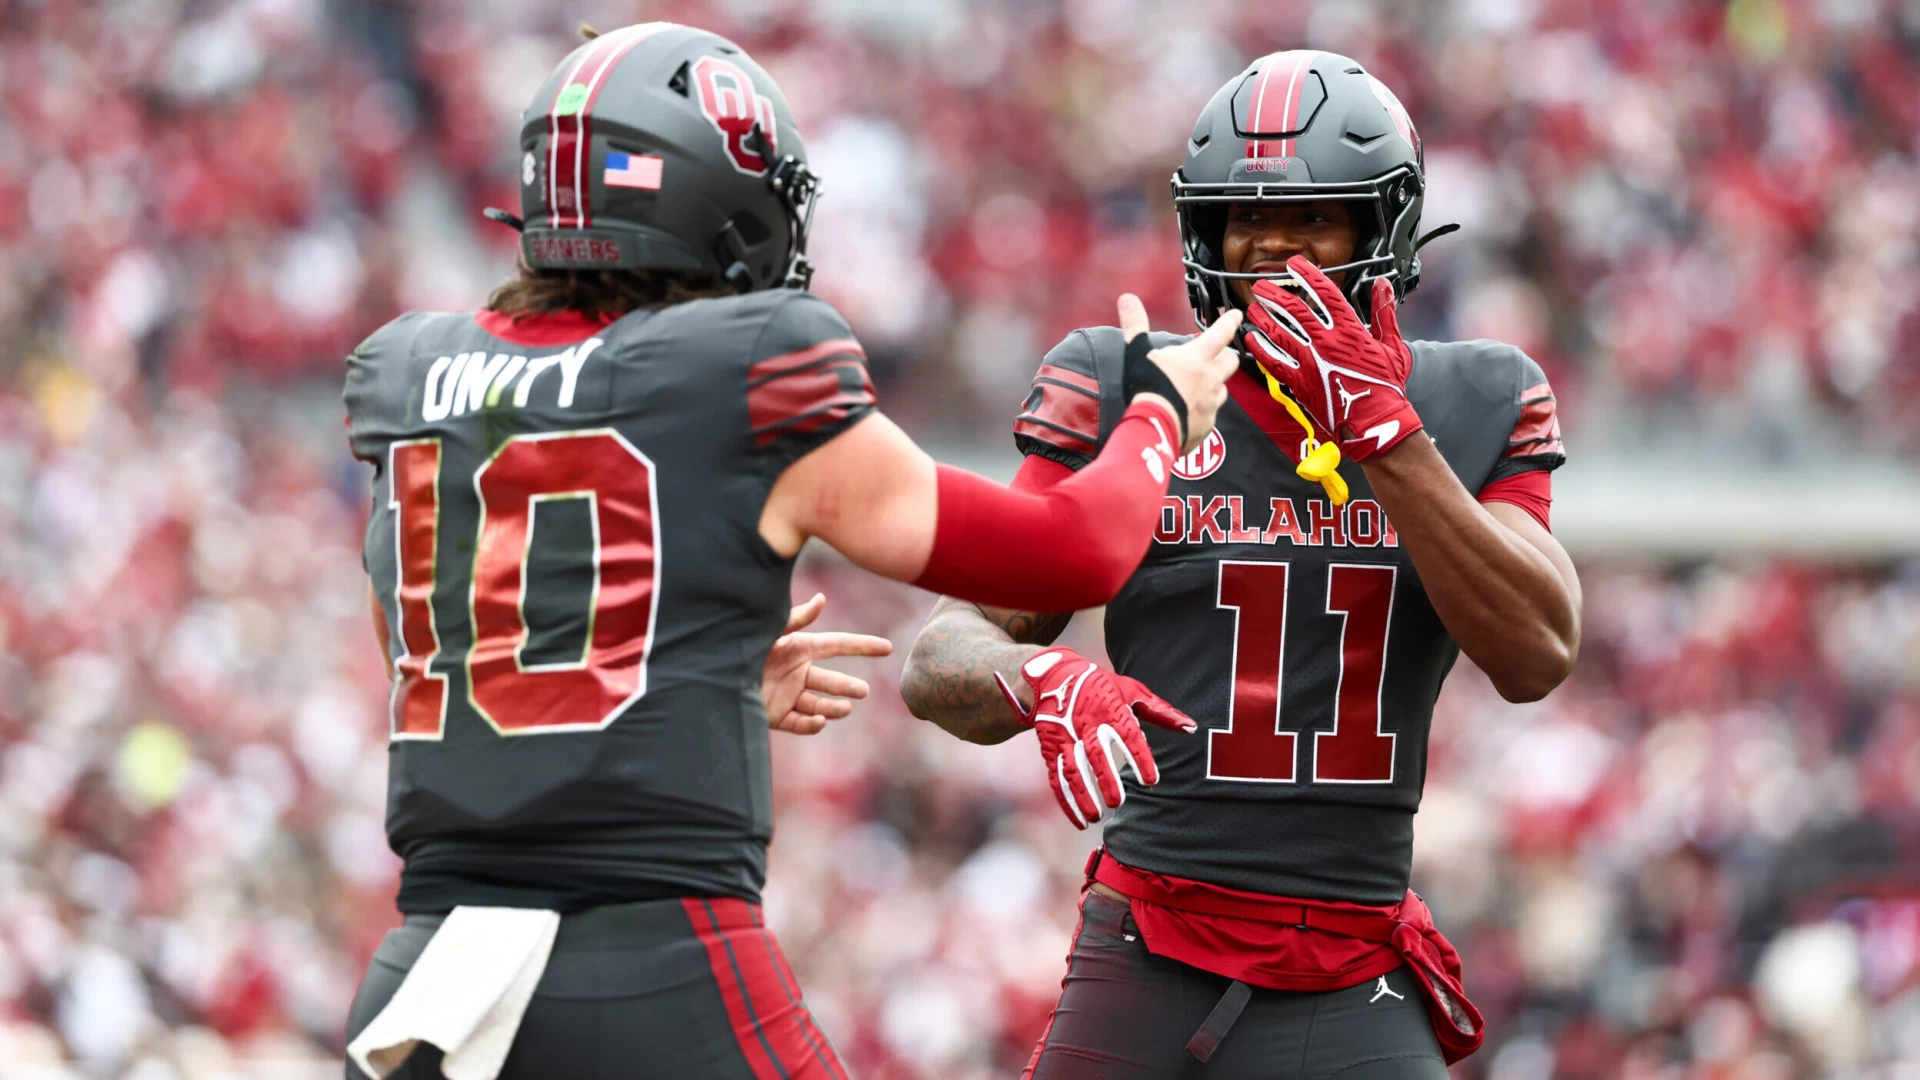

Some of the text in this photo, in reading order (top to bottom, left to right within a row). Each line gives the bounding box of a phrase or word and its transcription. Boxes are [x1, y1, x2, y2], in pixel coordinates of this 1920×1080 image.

[1245, 159, 1291, 172] UNITY
[422, 337, 604, 422] UNITY
[388, 427, 662, 741] 10
[1206, 559, 1398, 784] 11
